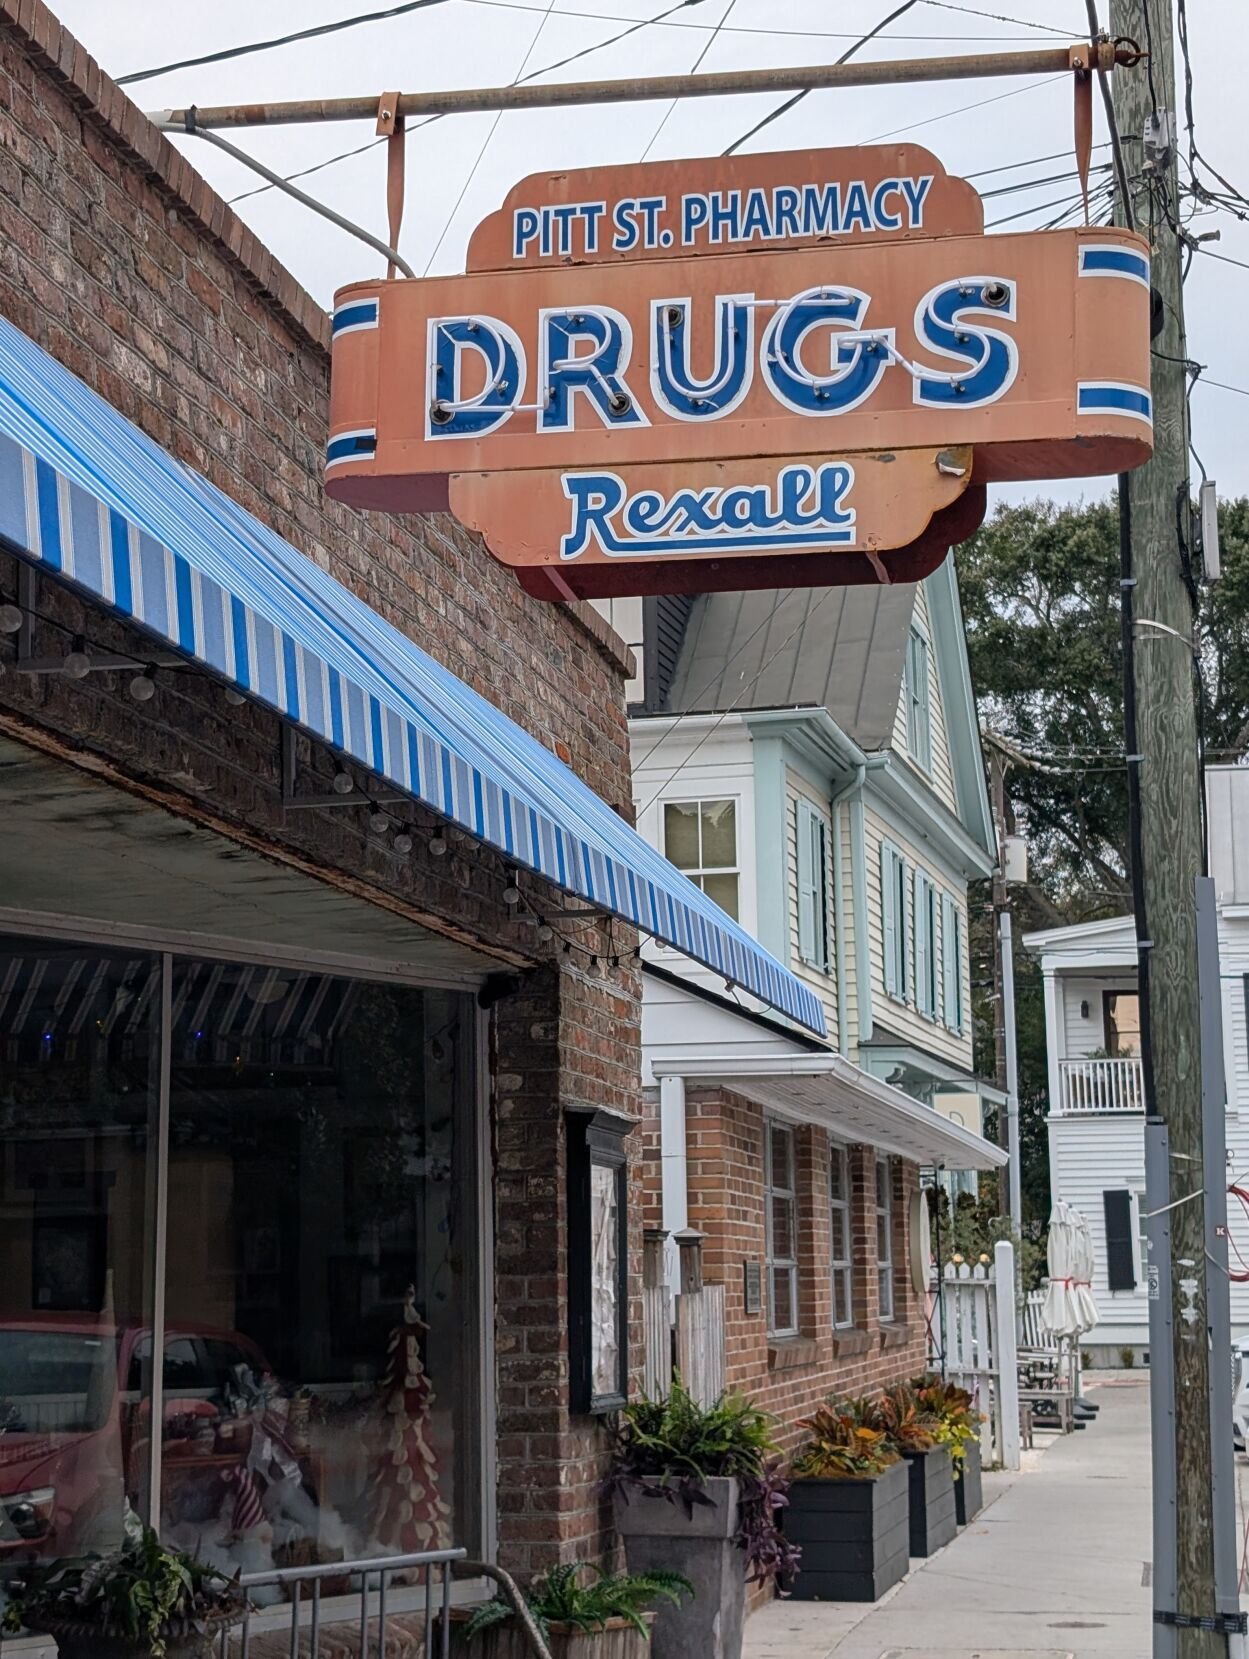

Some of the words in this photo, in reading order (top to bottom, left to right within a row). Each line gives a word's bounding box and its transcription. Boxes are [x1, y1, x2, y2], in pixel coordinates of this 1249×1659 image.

[513, 201, 606, 258] PITT
[612, 196, 674, 251] ST.
[681, 176, 934, 246] PHARMACY
[425, 275, 1019, 441] DRUGS
[560, 461, 856, 561] Rexall
